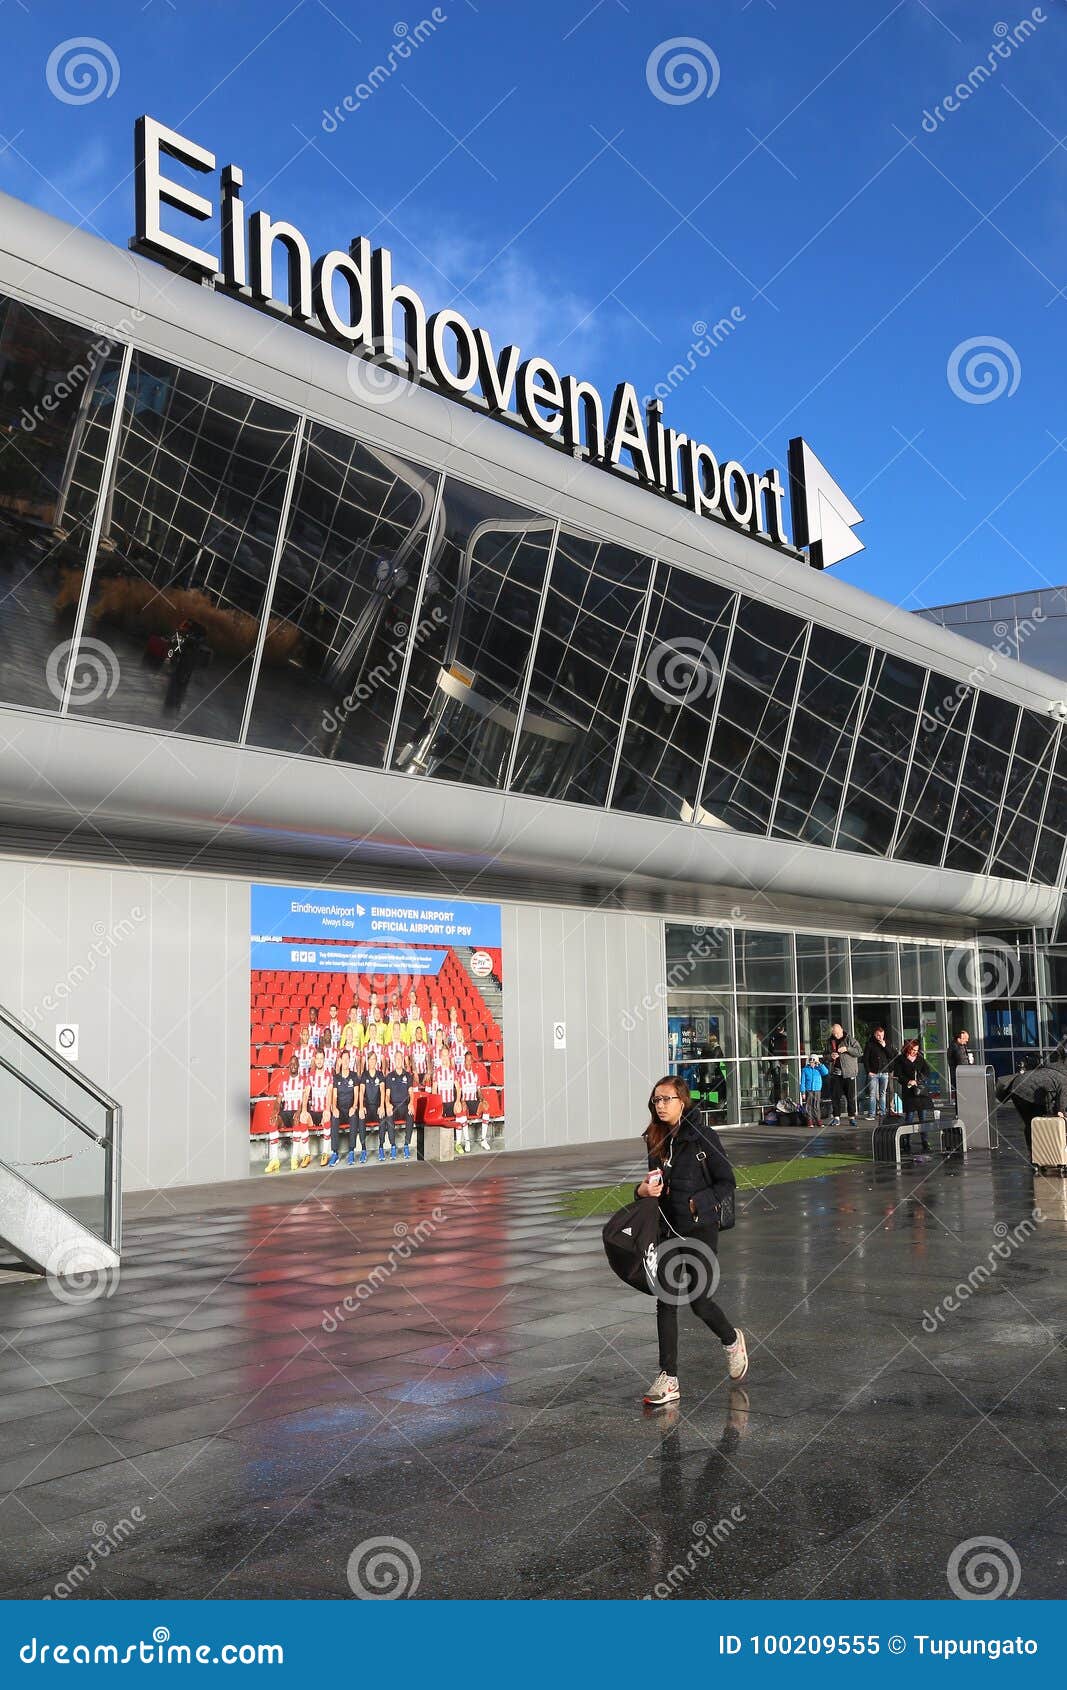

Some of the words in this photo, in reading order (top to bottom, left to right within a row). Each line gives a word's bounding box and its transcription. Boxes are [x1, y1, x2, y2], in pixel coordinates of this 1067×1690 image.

[371, 907, 420, 919] EINDHOVEN
[420, 911, 454, 921] AIRPORT
[322, 918, 341, 928] Always
[342, 920, 355, 928] Easy
[371, 921, 408, 932] OFFICIAL
[409, 923, 444, 934] AIRPORT
[445, 926, 456, 935] OF
[457, 927, 472, 935] PSV
